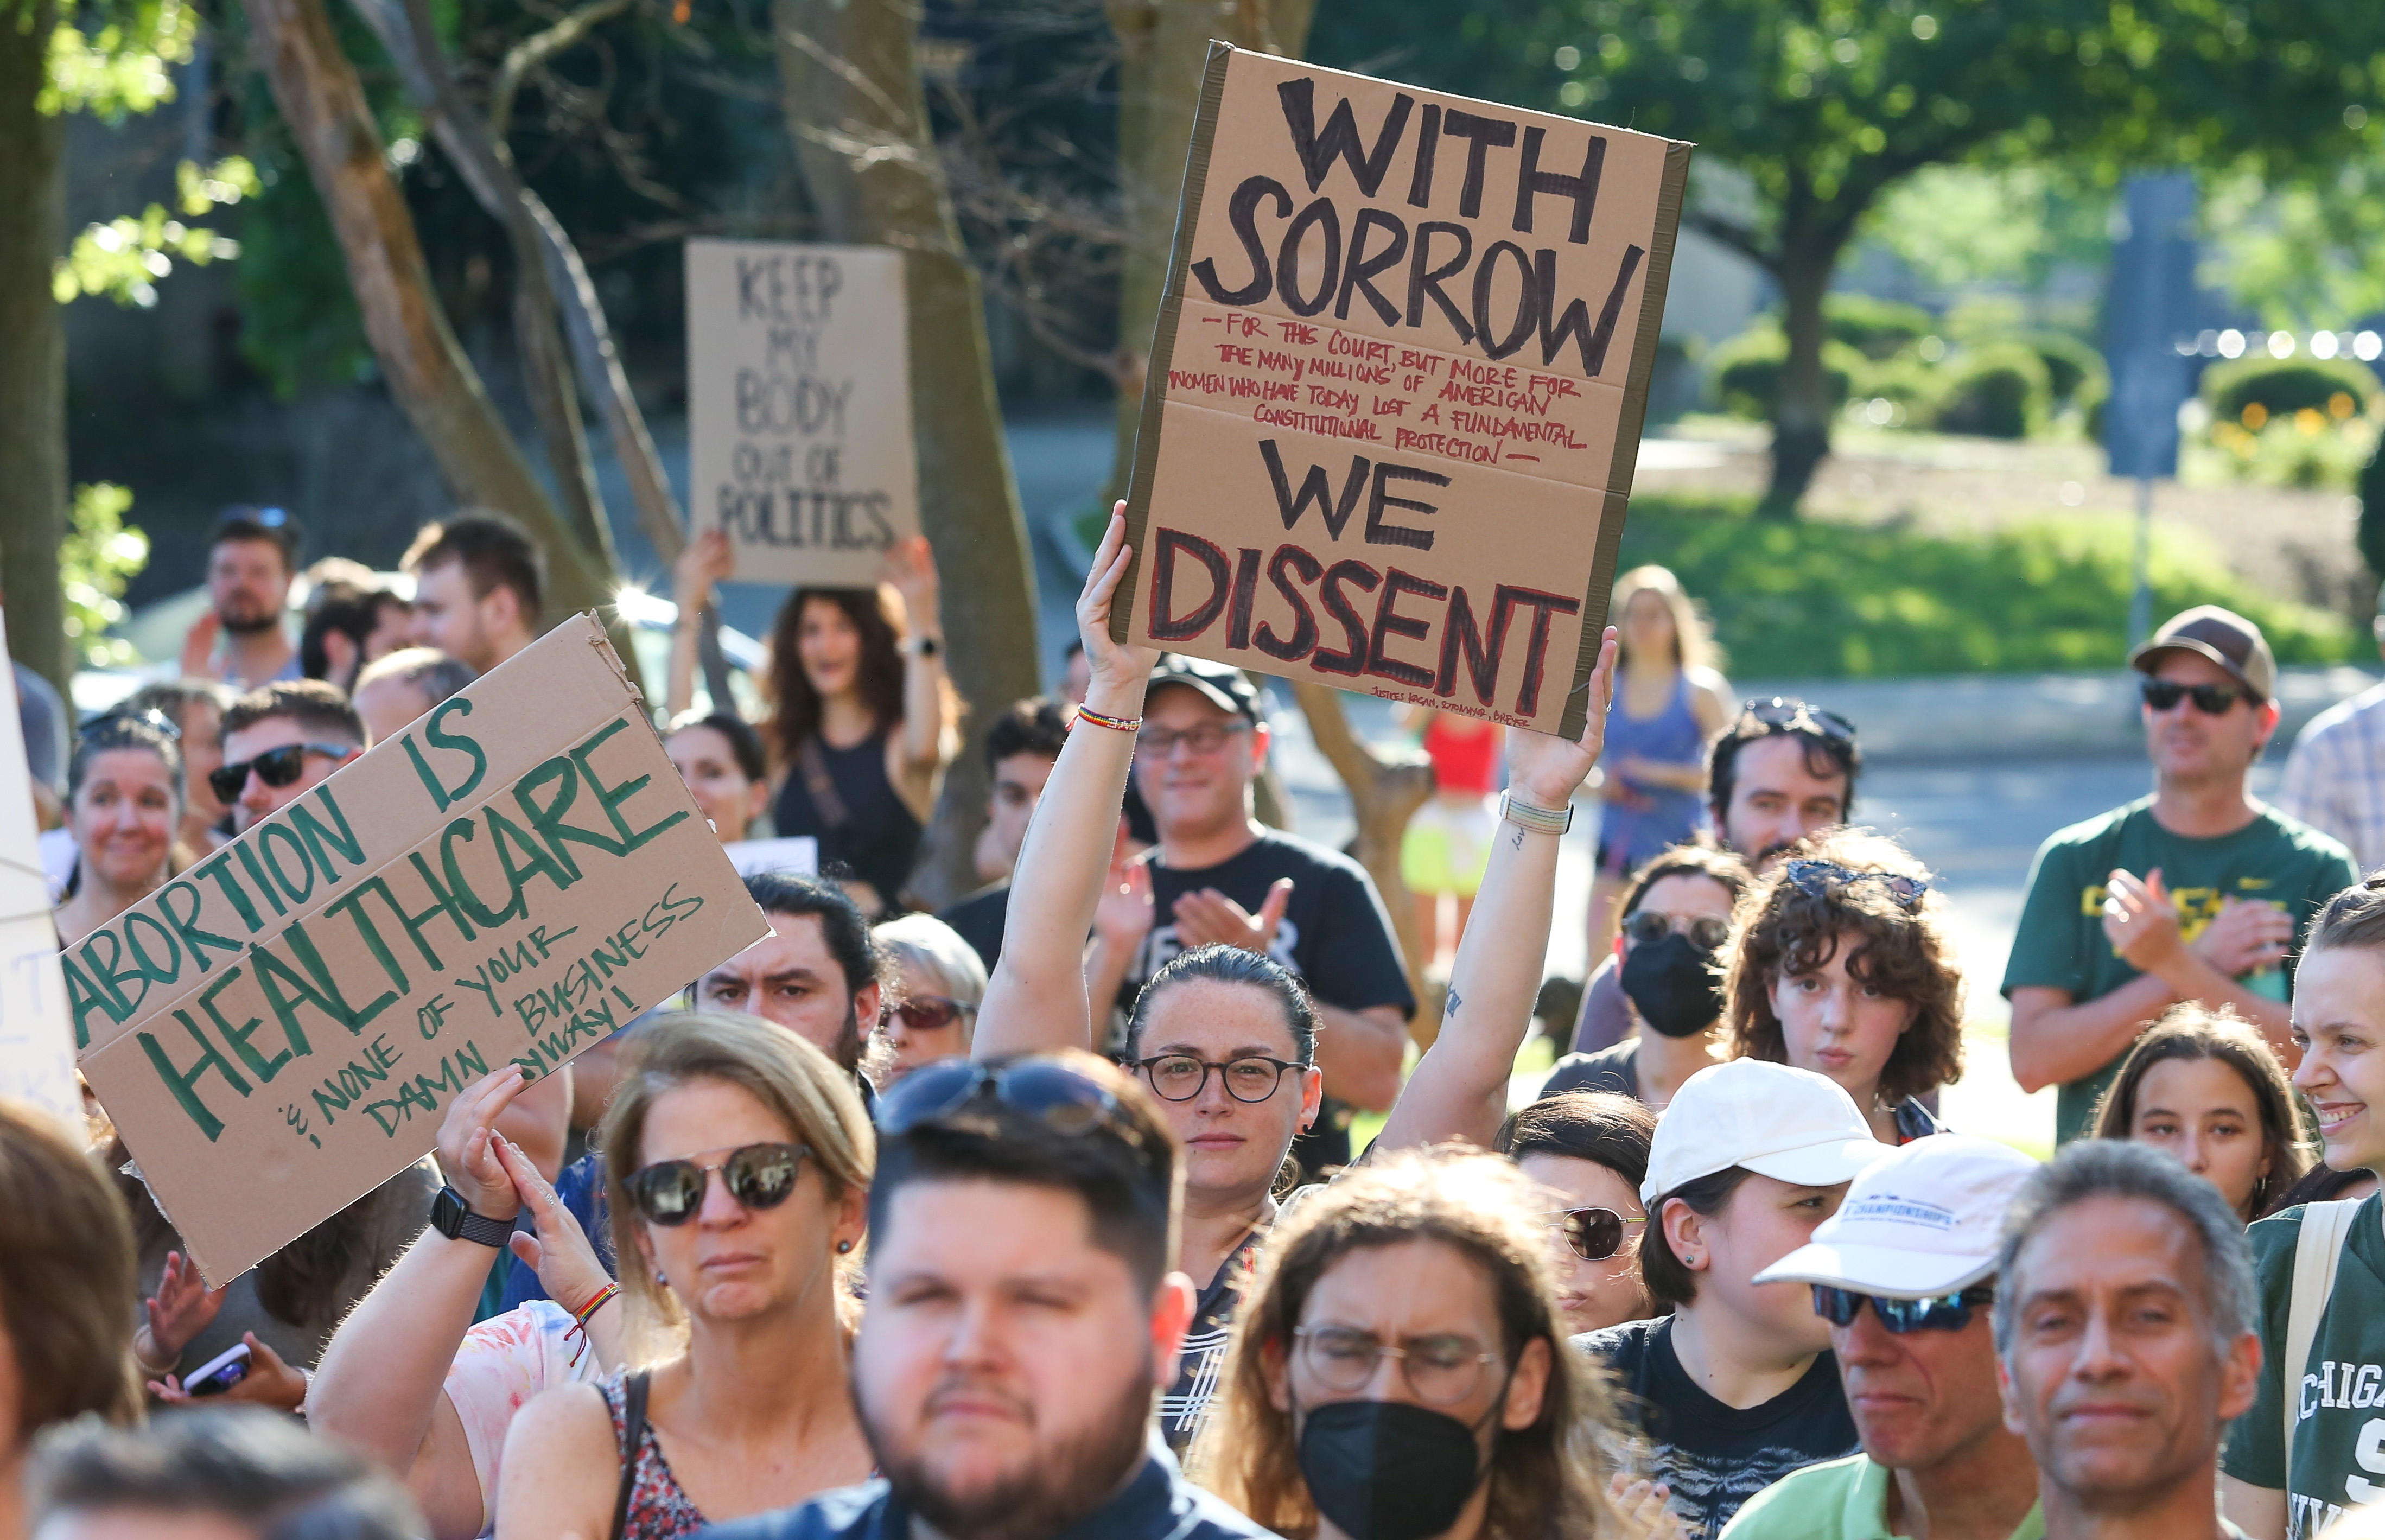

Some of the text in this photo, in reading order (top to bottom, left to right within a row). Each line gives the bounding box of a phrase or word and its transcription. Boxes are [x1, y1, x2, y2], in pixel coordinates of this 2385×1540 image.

[1277, 77, 1607, 244] WITH
[735, 254, 843, 322] KEEP
[1190, 175, 1645, 377] SORROW
[765, 327, 822, 371] MY
[1214, 344, 1254, 366] THE
[1257, 349, 1305, 381] MANY
[1403, 374, 1425, 393] OF
[1438, 380, 1551, 416] AMERICAN
[1277, 322, 1319, 345] THIS
[1398, 350, 1446, 376] BUT
[1449, 359, 1518, 389] MORE
[1528, 374, 1581, 398] FOR
[734, 367, 854, 435] BODY
[1168, 370, 1588, 449] WOMEN WHO HAVE TODAY LOST A FUNDAMENTAL
[1253, 403, 1382, 441] CONSTITUTIONAL
[732, 440, 841, 484] OUT OF
[1258, 438, 1452, 551] WE
[716, 482, 897, 551] POLITICS
[1148, 526, 1580, 718] DISSENT
[1370, 686, 1404, 701] JUSTICES
[1493, 710, 1530, 727] BREYER
[61, 697, 488, 1050] ABORTION IS
[136, 717, 690, 1143] HEALTHCARE
[311, 1032, 404, 1126] NONE
[417, 992, 455, 1039] OF
[454, 924, 579, 1017] YOUR
[361, 882, 705, 1138] DAMN BUSINESS
